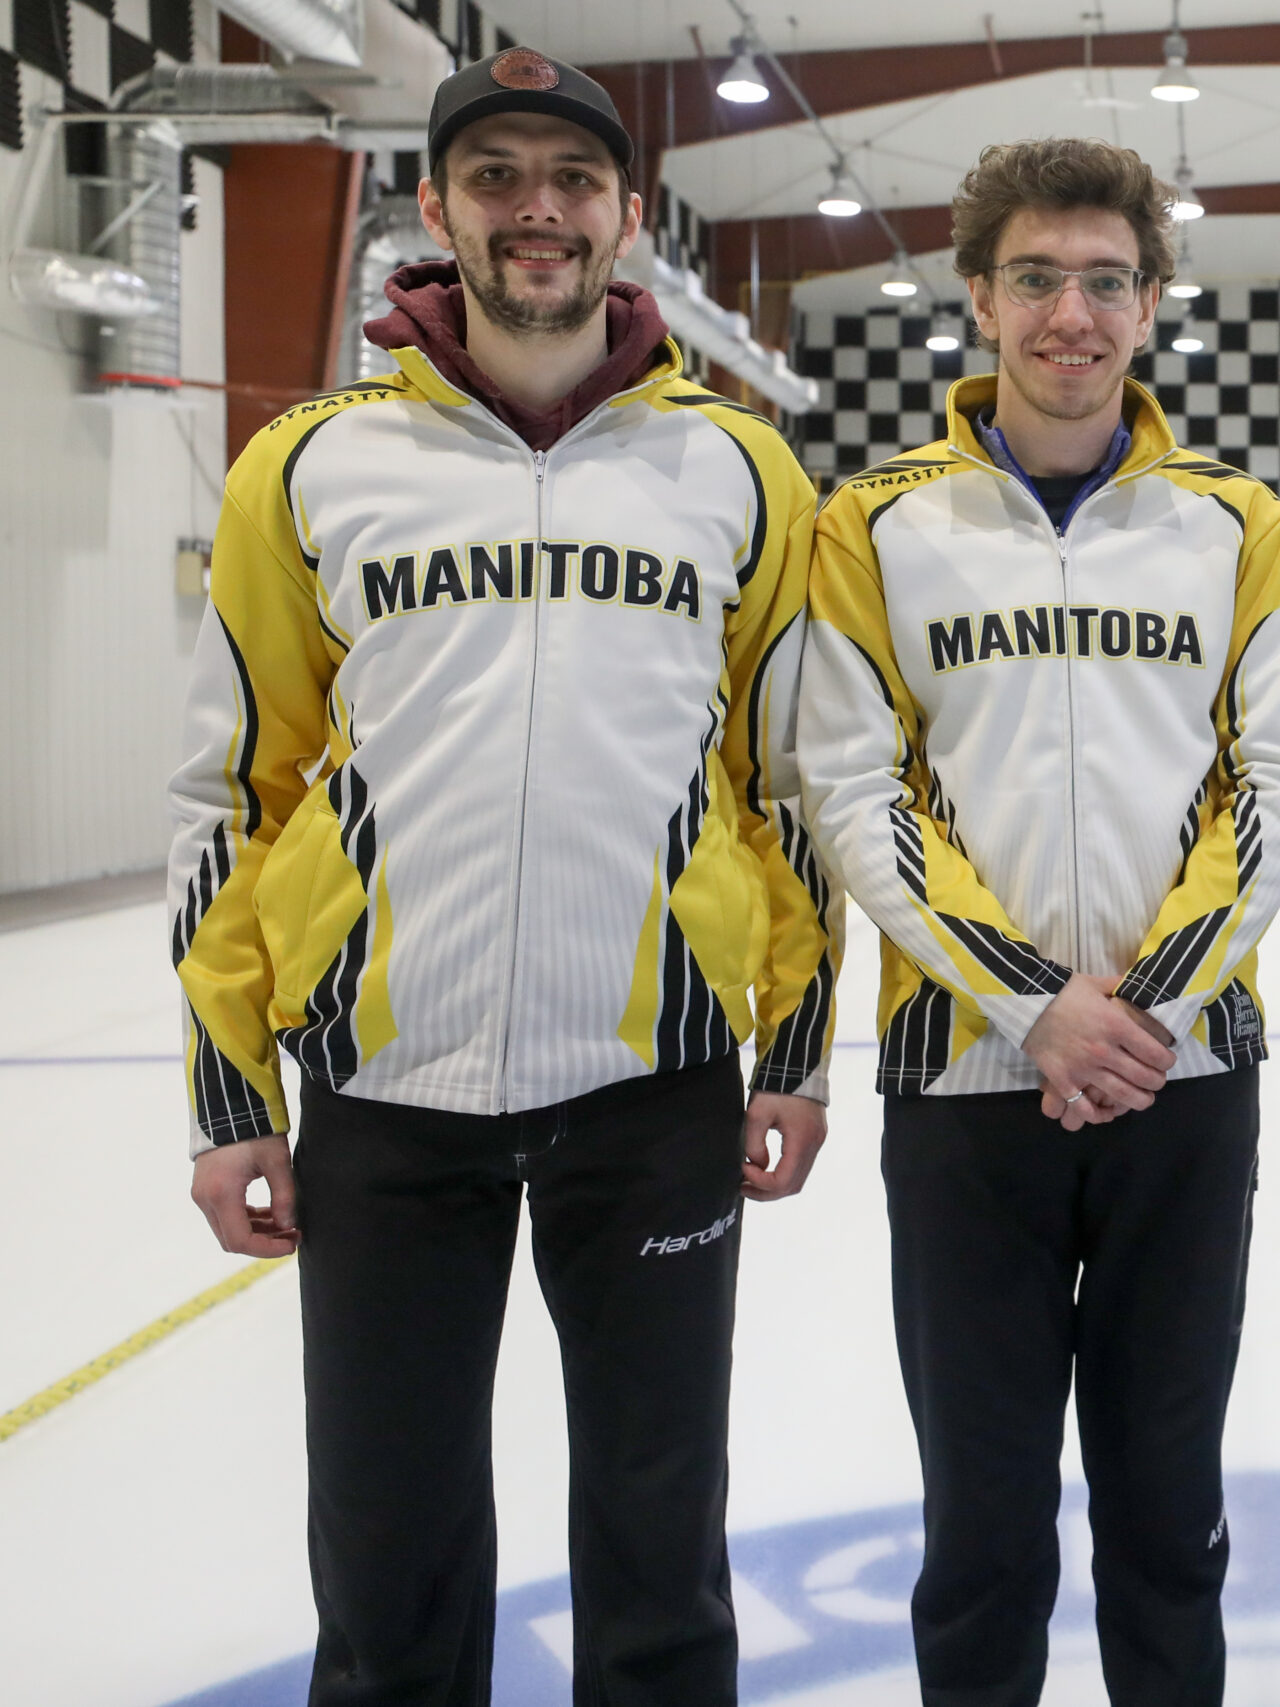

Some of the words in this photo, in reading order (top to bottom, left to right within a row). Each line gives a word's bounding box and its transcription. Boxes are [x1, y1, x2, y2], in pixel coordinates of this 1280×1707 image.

[269, 390, 390, 432] DYNASTY
[851, 466, 947, 489] DYNASTY
[360, 540, 701, 623] MANITOBA
[926, 605, 1205, 675] MANITOBA
